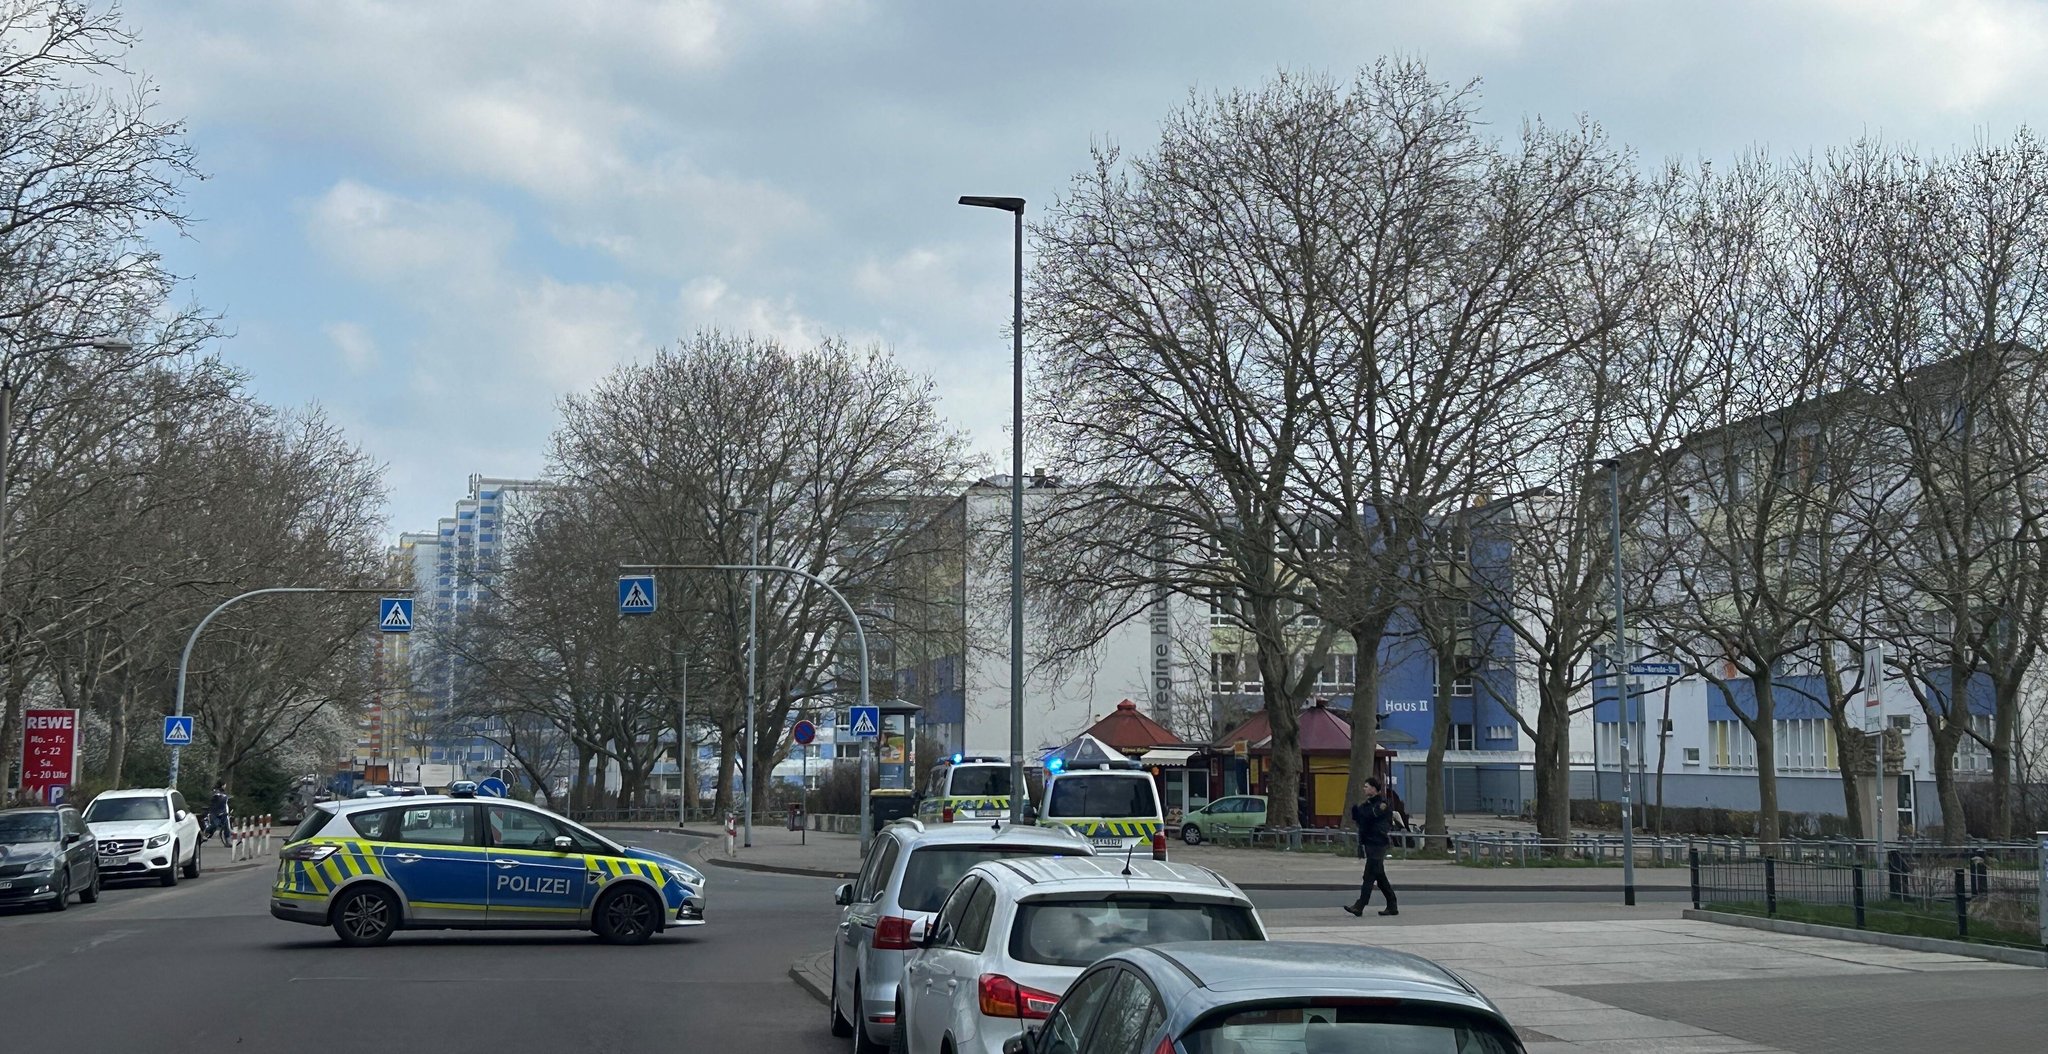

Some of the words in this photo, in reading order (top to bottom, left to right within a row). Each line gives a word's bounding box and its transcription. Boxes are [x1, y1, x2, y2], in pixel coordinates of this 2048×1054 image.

[1151, 643, 1172, 712] regine
[1385, 699, 1417, 712] Haus
[26, 716, 73, 730] REWE
[30, 735, 46, 744] Mo.
[55, 735, 66, 744] Fr.
[34, 746, 40, 756] 6
[49, 747, 61, 756] 22
[40, 759, 54, 767] Sa.
[24, 770, 31, 779] 6
[39, 770, 51, 779] 20
[52, 770, 68, 779] Uhr
[50, 786, 64, 804] P
[497, 875, 571, 895] POLIZEI
